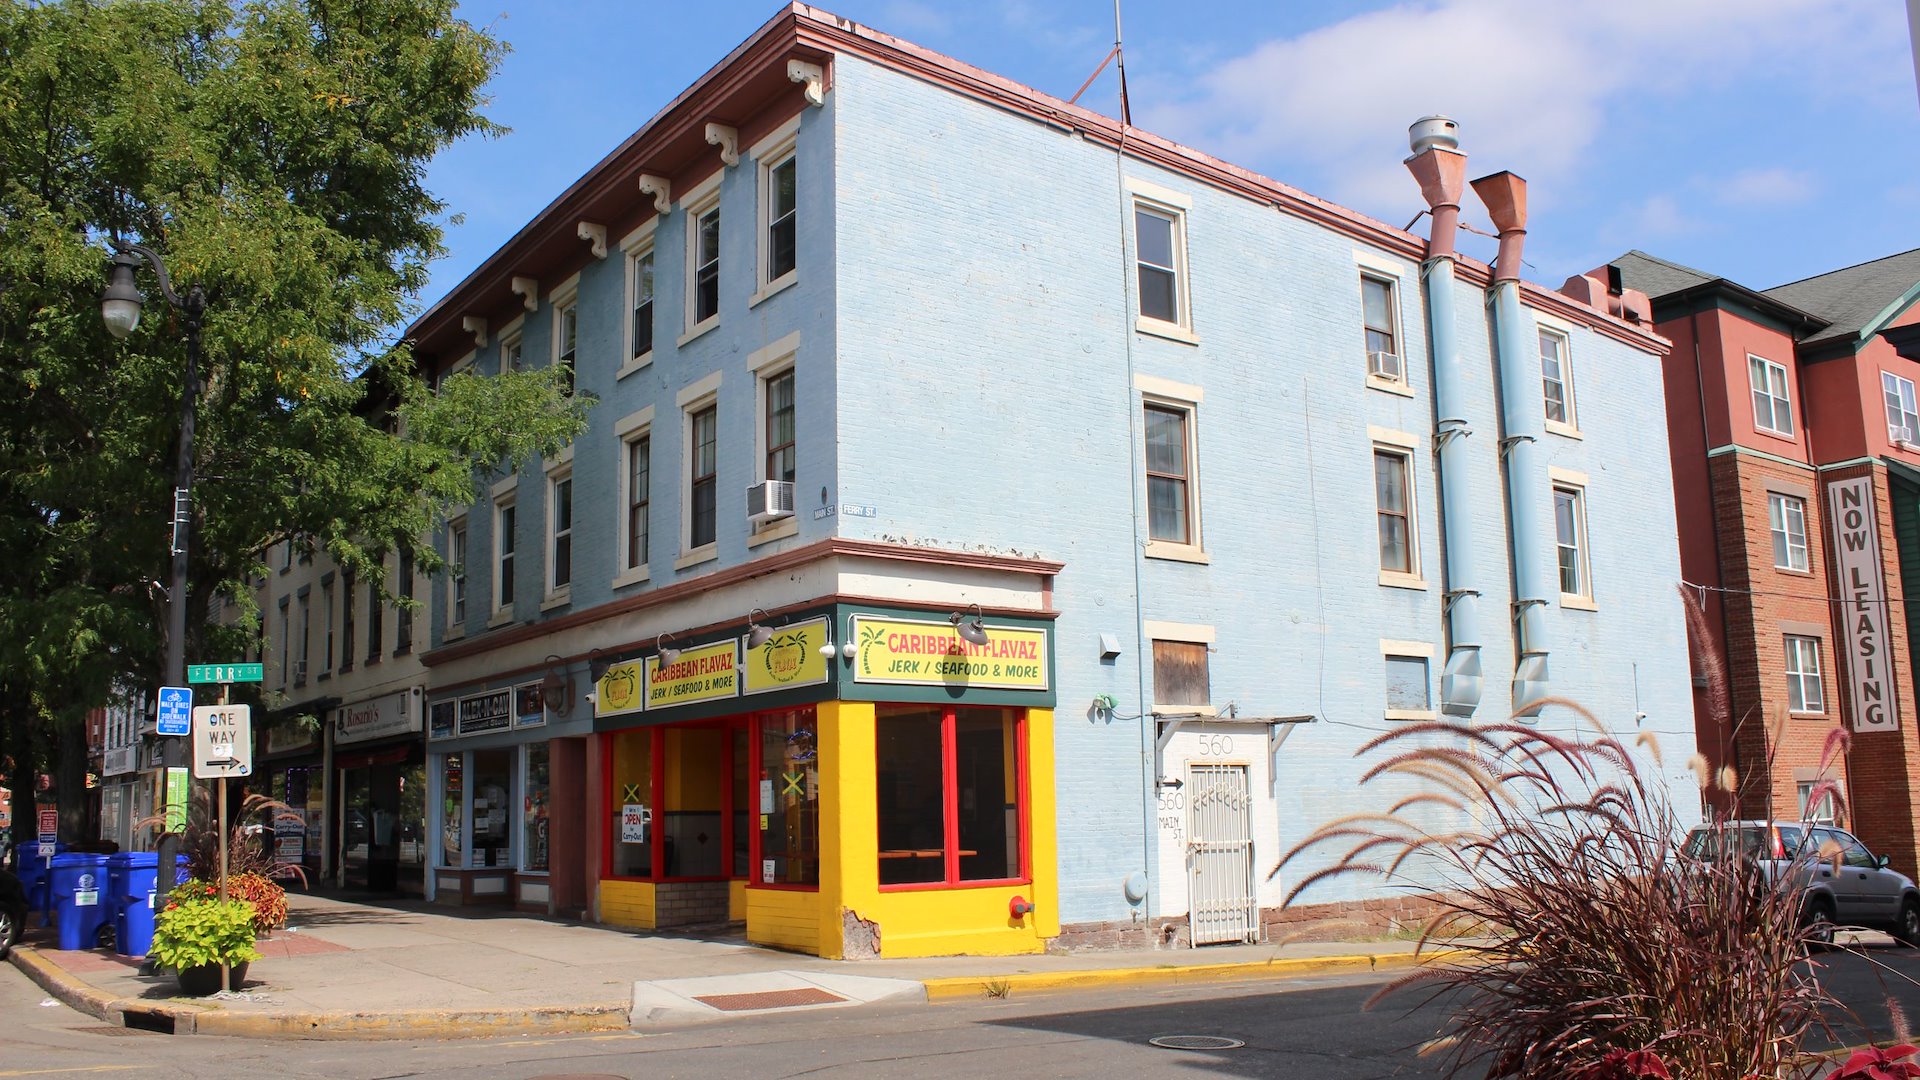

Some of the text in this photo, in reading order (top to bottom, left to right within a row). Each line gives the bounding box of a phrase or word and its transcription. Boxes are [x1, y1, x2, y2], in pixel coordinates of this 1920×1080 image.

[844, 504, 864, 515] FERRY
[1840, 485, 1884, 725] NOW LEASING
[888, 633, 1037, 660] CARIBBEAN FLAVAZ
[195, 667, 242, 680] FERRY
[651, 652, 733, 684] CARIBBEAN FLAVAZ
[888, 659, 920, 673] JERK
[934, 661, 988, 676] SEAFOOD
[992, 664, 1001, 677] &
[1005, 665, 1038, 678] MORE
[651, 686, 666, 700] JERK
[673, 681, 703, 697] SEAFOOD
[704, 679, 710, 691] &
[712, 675, 733, 690] MORE
[209, 713, 235, 727] ONE
[209, 731, 237, 744] WAY
[1199, 734, 1234, 756] 560
[1158, 792, 1185, 811] 560
[625, 814, 641, 825] OPEN
[1158, 816, 1179, 829] MAIN
